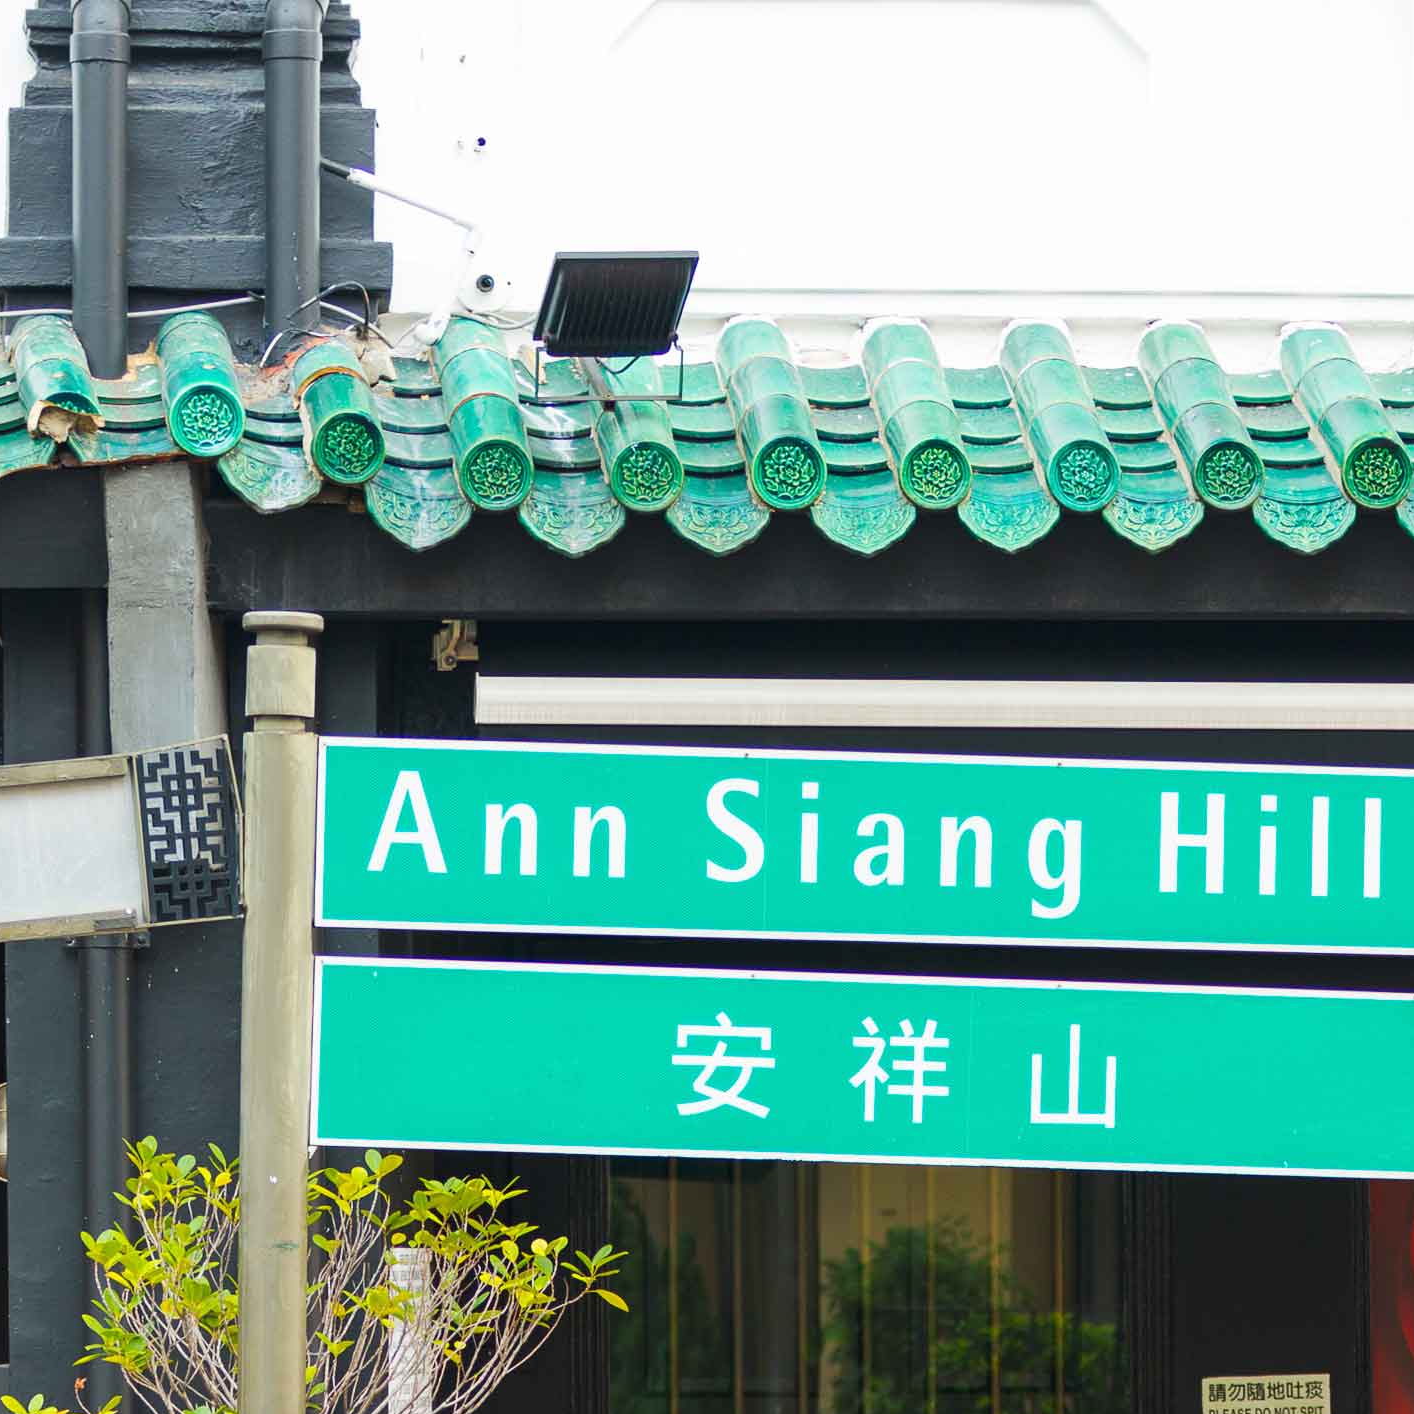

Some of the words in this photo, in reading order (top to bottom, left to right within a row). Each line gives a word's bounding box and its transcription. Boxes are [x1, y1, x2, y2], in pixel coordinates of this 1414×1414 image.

[368, 770, 627, 878] Ann
[706, 778, 1085, 919] Siang
[1159, 791, 1382, 899] Hill
[671, 1011, 1117, 1129] 安祥山
